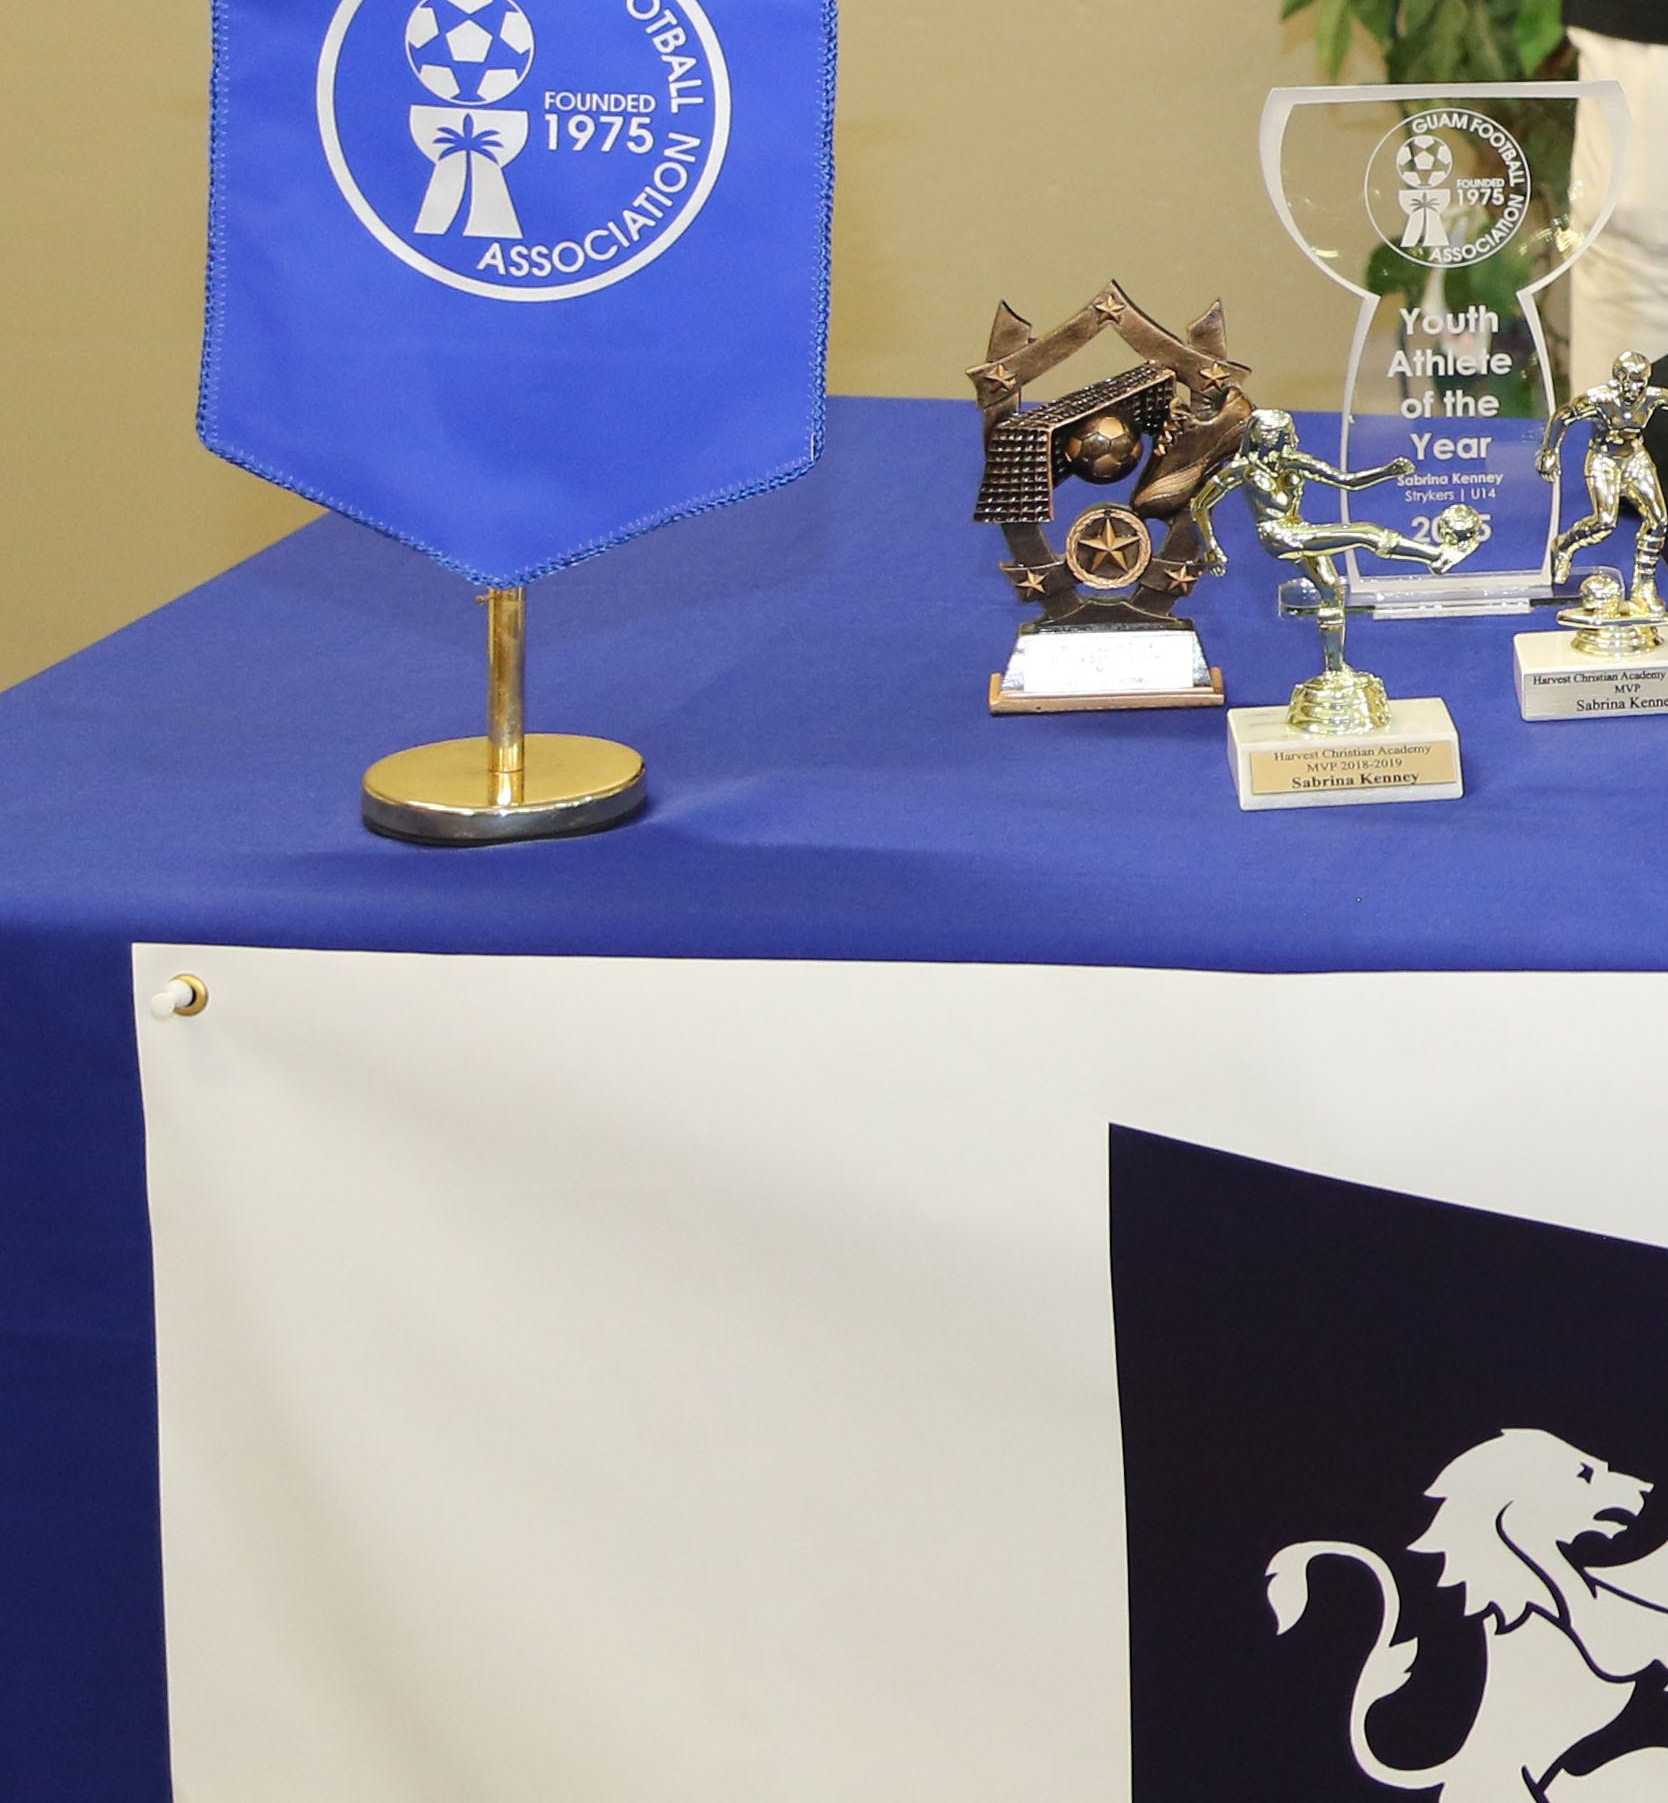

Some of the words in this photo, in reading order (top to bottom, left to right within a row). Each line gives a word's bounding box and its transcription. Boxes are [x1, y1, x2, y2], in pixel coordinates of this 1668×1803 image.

[543, 91, 656, 114] FOUNDED
[545, 115, 655, 154] 1975
[1412, 113, 1468, 134] GUAM
[1469, 119, 1525, 187] FOOTBALL
[1456, 178, 1505, 188] FOUNDED
[476, 131, 701, 277] ASSOCIATION
[1457, 189, 1504, 205] 1975
[1428, 194, 1525, 263] ASSOCIATION
[1399, 305, 1499, 336] Youth
[1387, 349, 1513, 378] Athlete
[1400, 390, 1435, 419] of
[1443, 389, 1500, 417] the
[1409, 432, 1492, 461] Year
[1396, 473, 1449, 487] Sabrina
[1452, 472, 1503, 486] Kenney
[1404, 490, 1455, 503] Strykers
[1470, 487, 1497, 500] U14
[1533, 675, 1571, 685] Harvest
[1574, 673, 1618, 683] Christian
[1621, 671, 1665, 682] Academy
[1614, 684, 1641, 694] MVP
[1576, 699, 1625, 712] Sabrina
[1274, 751, 1319, 762] Harvest
[1322, 747, 1375, 759] Christian
[1378, 744, 1432, 756] Academy
[1307, 763, 1338, 773] MVP
[1341, 758, 1403, 771] 2018-2019
[1291, 775, 1355, 789] Sabrina
[1360, 772, 1419, 785] Kenney
